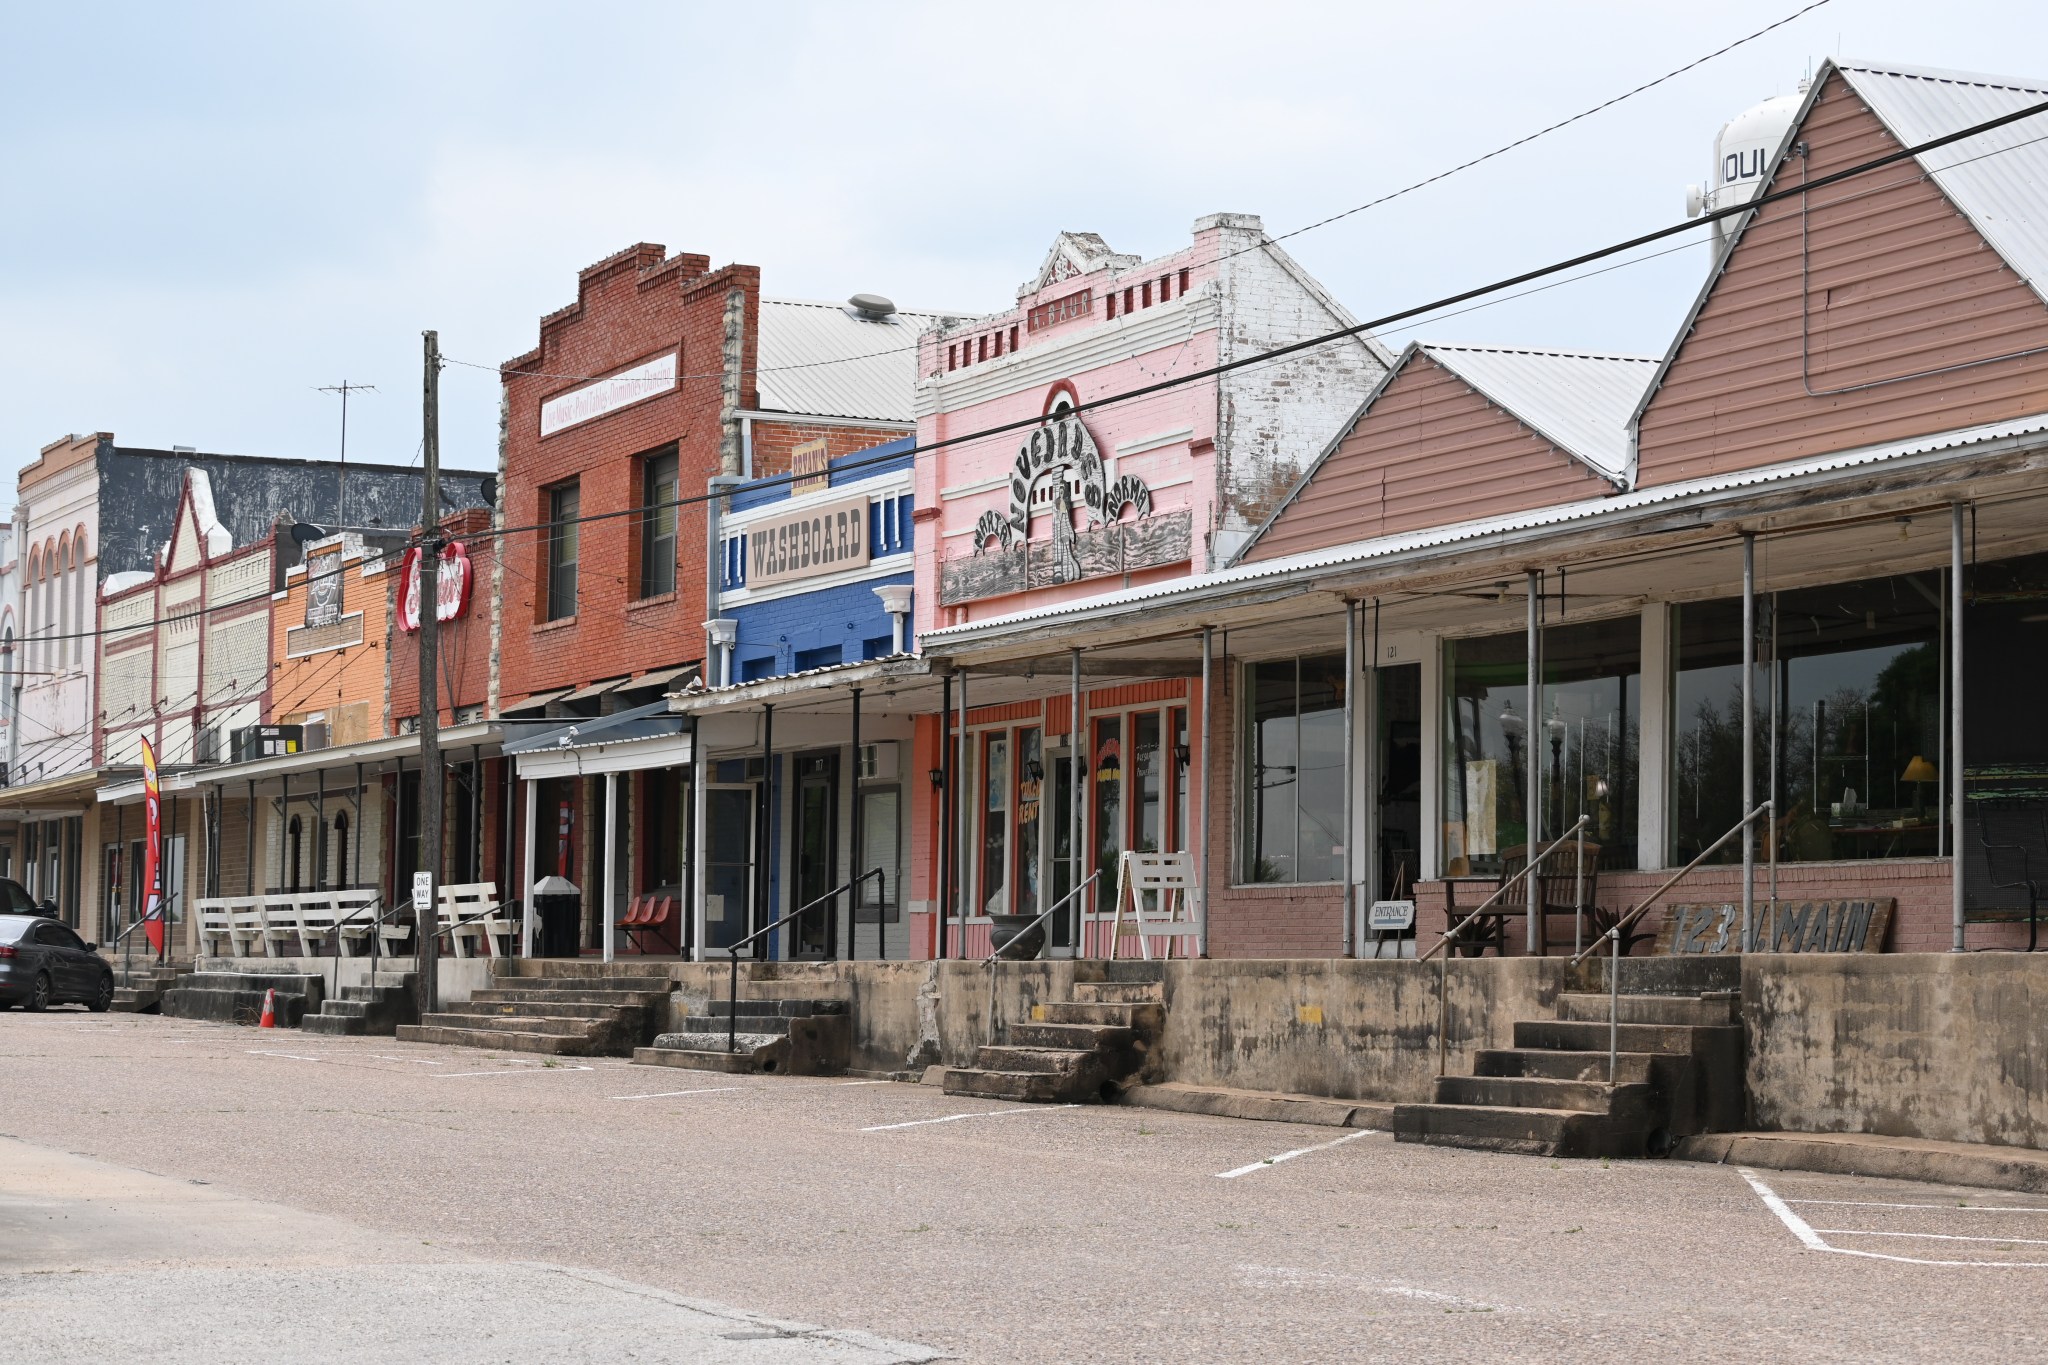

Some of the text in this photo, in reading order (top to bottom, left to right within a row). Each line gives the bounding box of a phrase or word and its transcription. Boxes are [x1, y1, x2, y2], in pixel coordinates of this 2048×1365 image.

[1721, 148, 1766, 184] OUL
[1049, 291, 1088, 328] BAUR
[557, 398, 572, 423] Music
[575, 390, 588, 418] Pool
[589, 386, 607, 414] Tables
[610, 377, 640, 405] Dominoes
[644, 362, 670, 392] Dancing
[793, 447, 826, 488] BRYAN'S
[1107, 475, 1146, 516] NORMA
[752, 508, 861, 578] WASHBOARD
[974, 510, 1008, 548] MARIA
[1387, 645, 1397, 659] 121
[416, 877, 429, 886] ONE
[416, 889, 429, 898] WAY
[1375, 905, 1409, 919] ENTRANCE
[1670, 904, 1736, 953] 123
